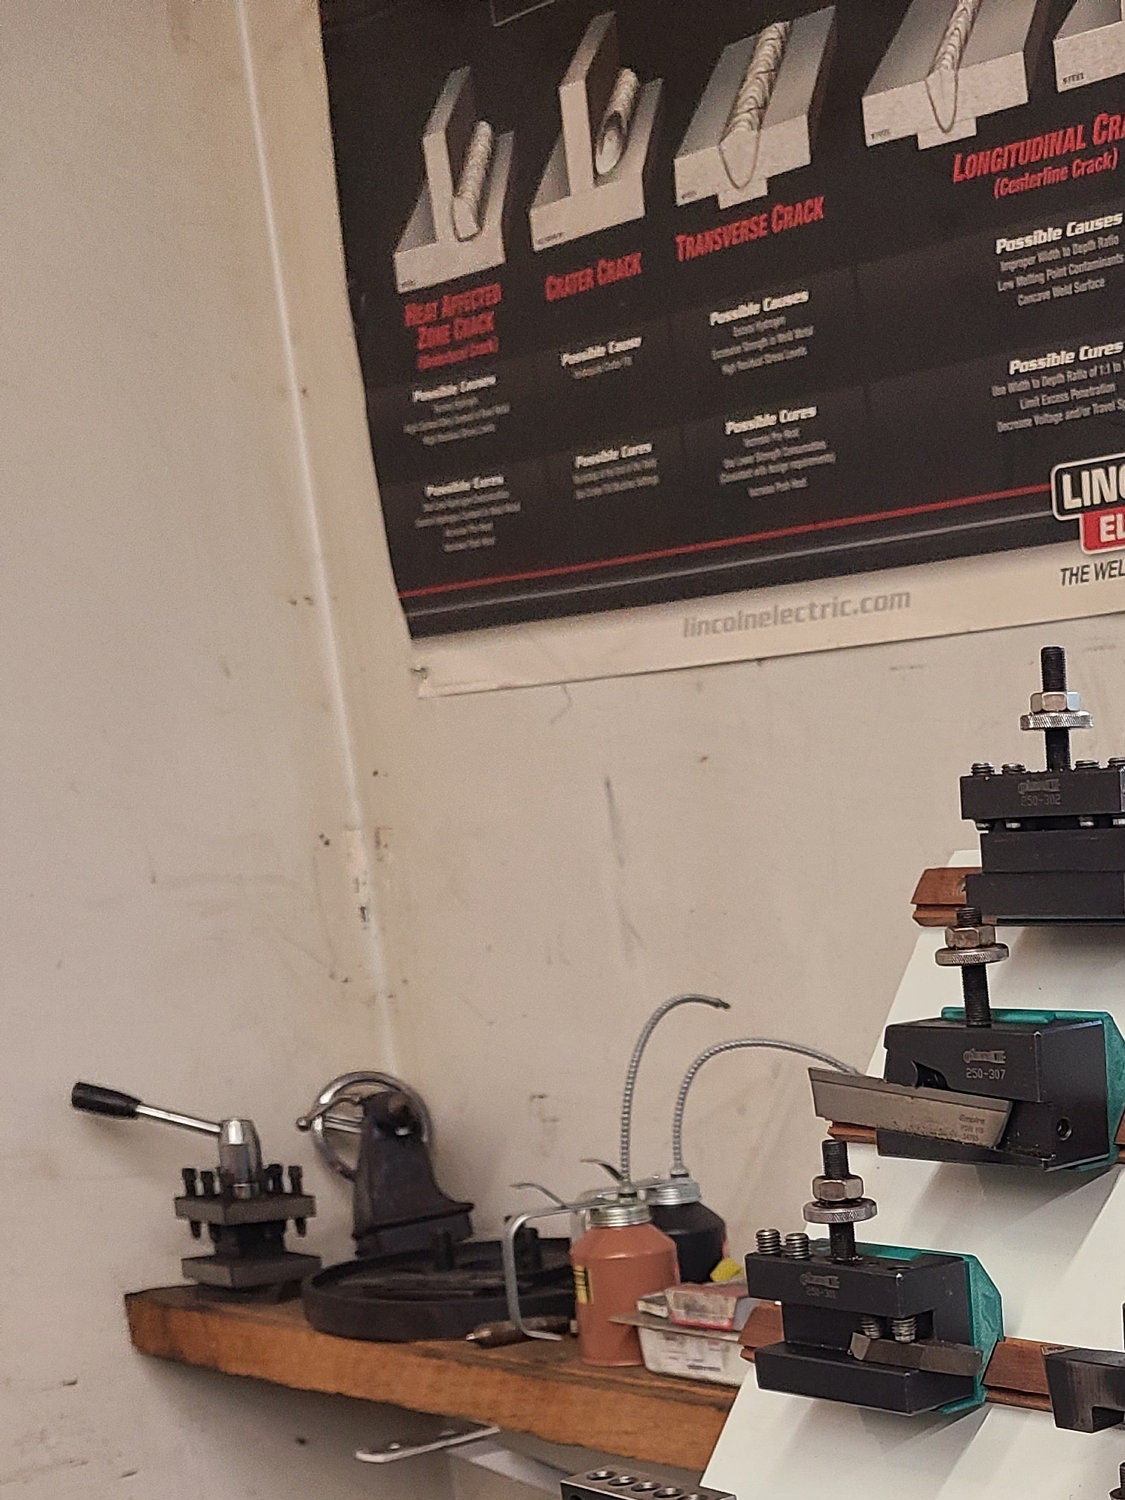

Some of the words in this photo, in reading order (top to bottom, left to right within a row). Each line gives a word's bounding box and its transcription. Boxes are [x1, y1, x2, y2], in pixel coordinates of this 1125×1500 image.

[953, 124, 1086, 183] LONGITUDINAL
[994, 166, 1068, 199] (Centerline
[1072, 148, 1119, 179] Crack)
[675, 213, 768, 262] TRANSVERSE
[771, 196, 824, 233] CRACK
[996, 227, 1062, 254] Possible
[1066, 213, 1123, 237] Causes
[545, 267, 594, 302] CRATER
[597, 252, 642, 285] CRACK
[1009, 350, 1075, 375] Possible
[1079, 341, 1124, 361] Cures
[1060, 565, 1090, 586] THE
[682, 591, 911, 638] lincolnelectric.com
[966, 1067, 1006, 1080] 250-307
